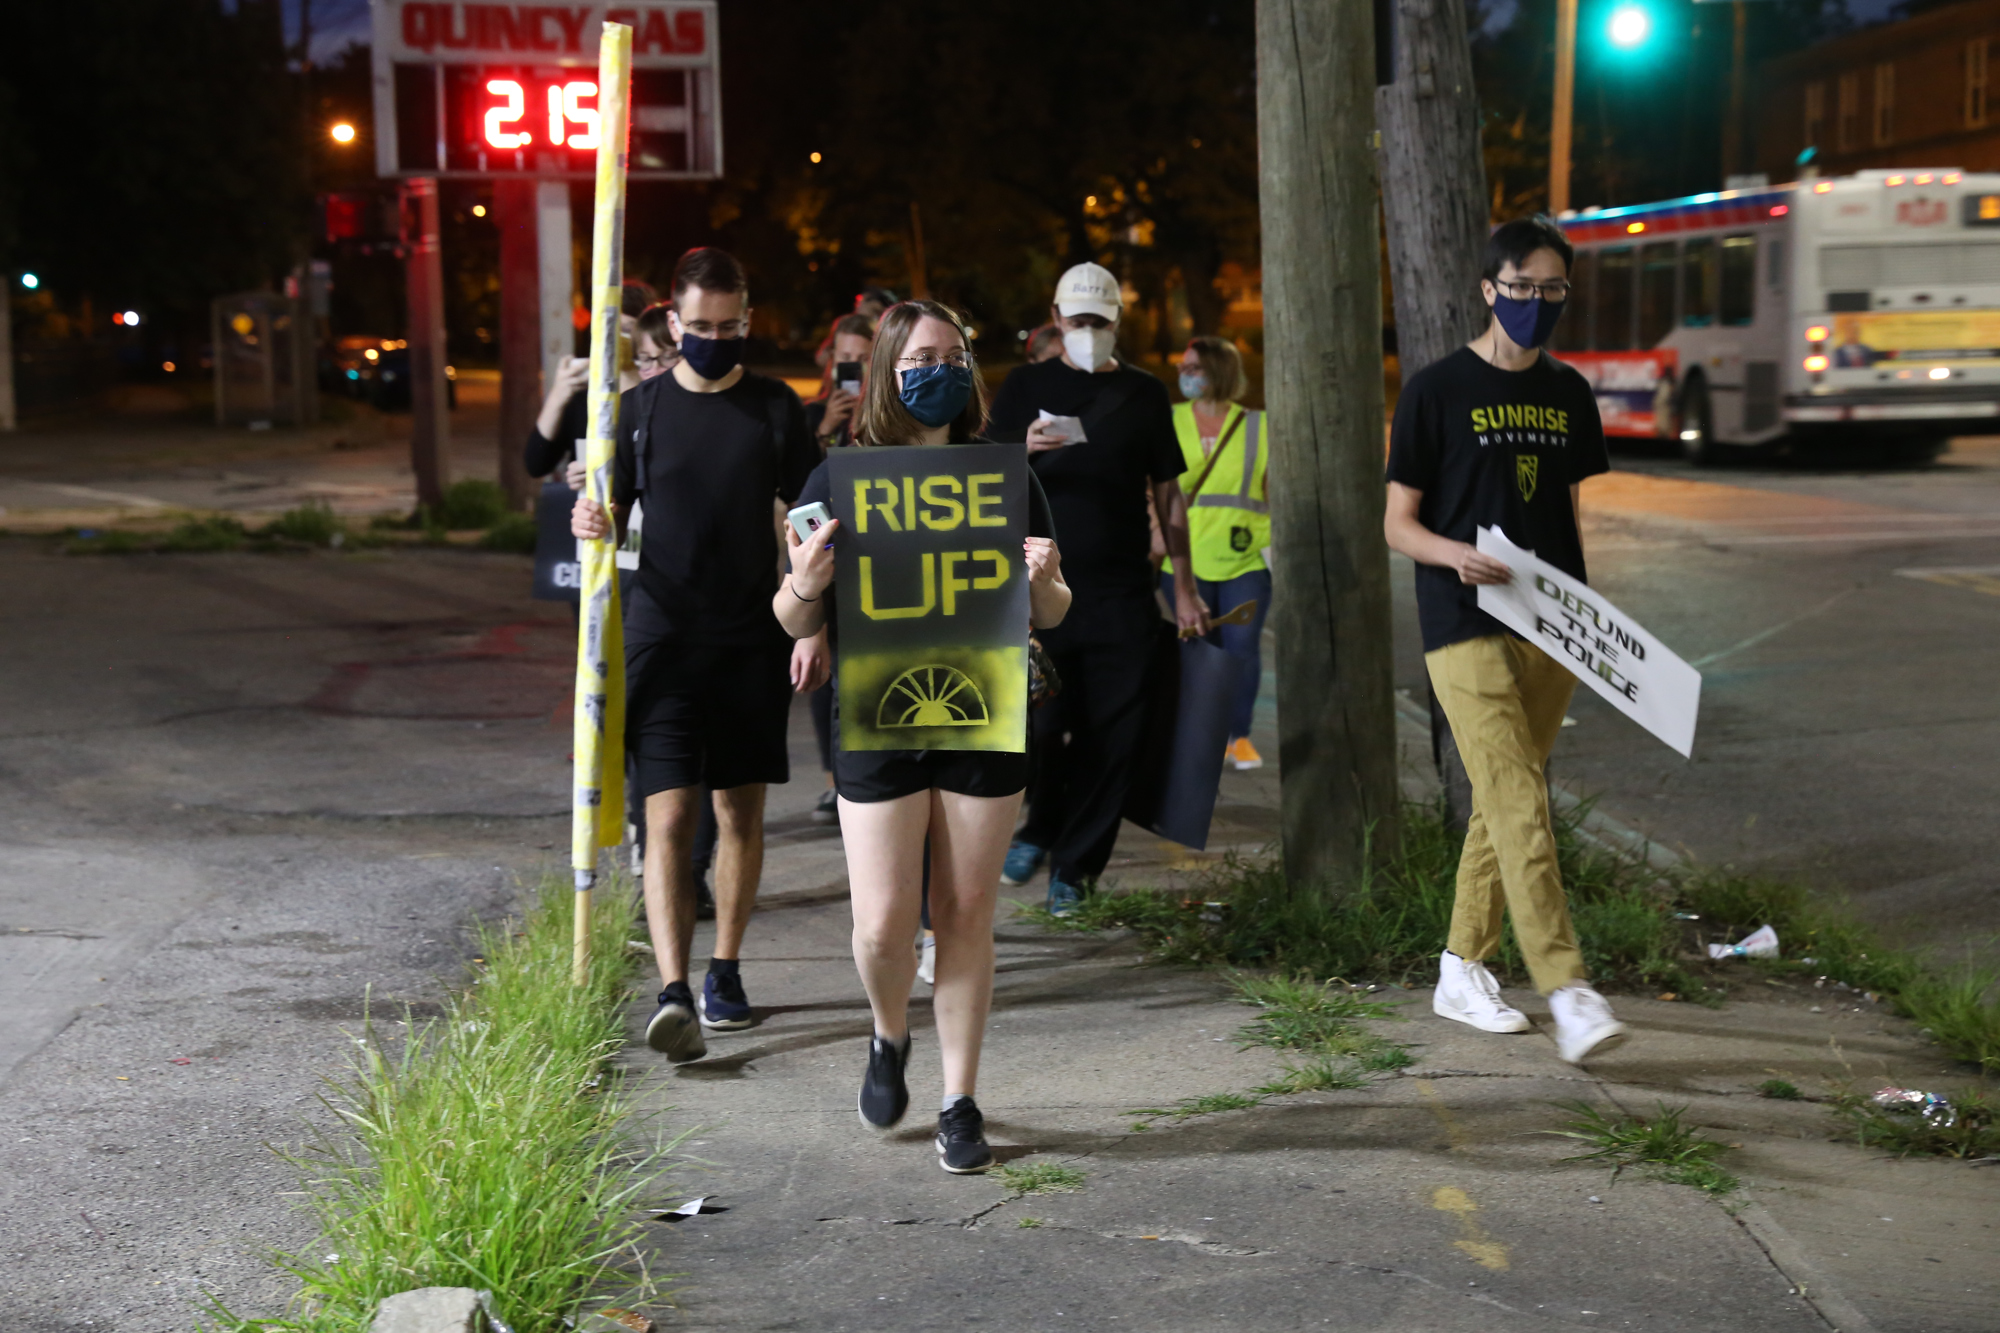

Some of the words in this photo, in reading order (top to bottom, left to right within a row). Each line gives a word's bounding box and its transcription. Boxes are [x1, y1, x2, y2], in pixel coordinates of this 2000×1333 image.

[402, 3, 593, 53] QUINCY
[1471, 404, 1569, 434] SUNRISE
[1479, 432, 1567, 447] MOVEMENT
[853, 473, 1008, 533] RISE
[859, 550, 1011, 621] UP
[1535, 573, 1647, 662] DEFUND
[1560, 610, 1620, 665] THE
[1534, 614, 1639, 704] POLICE
